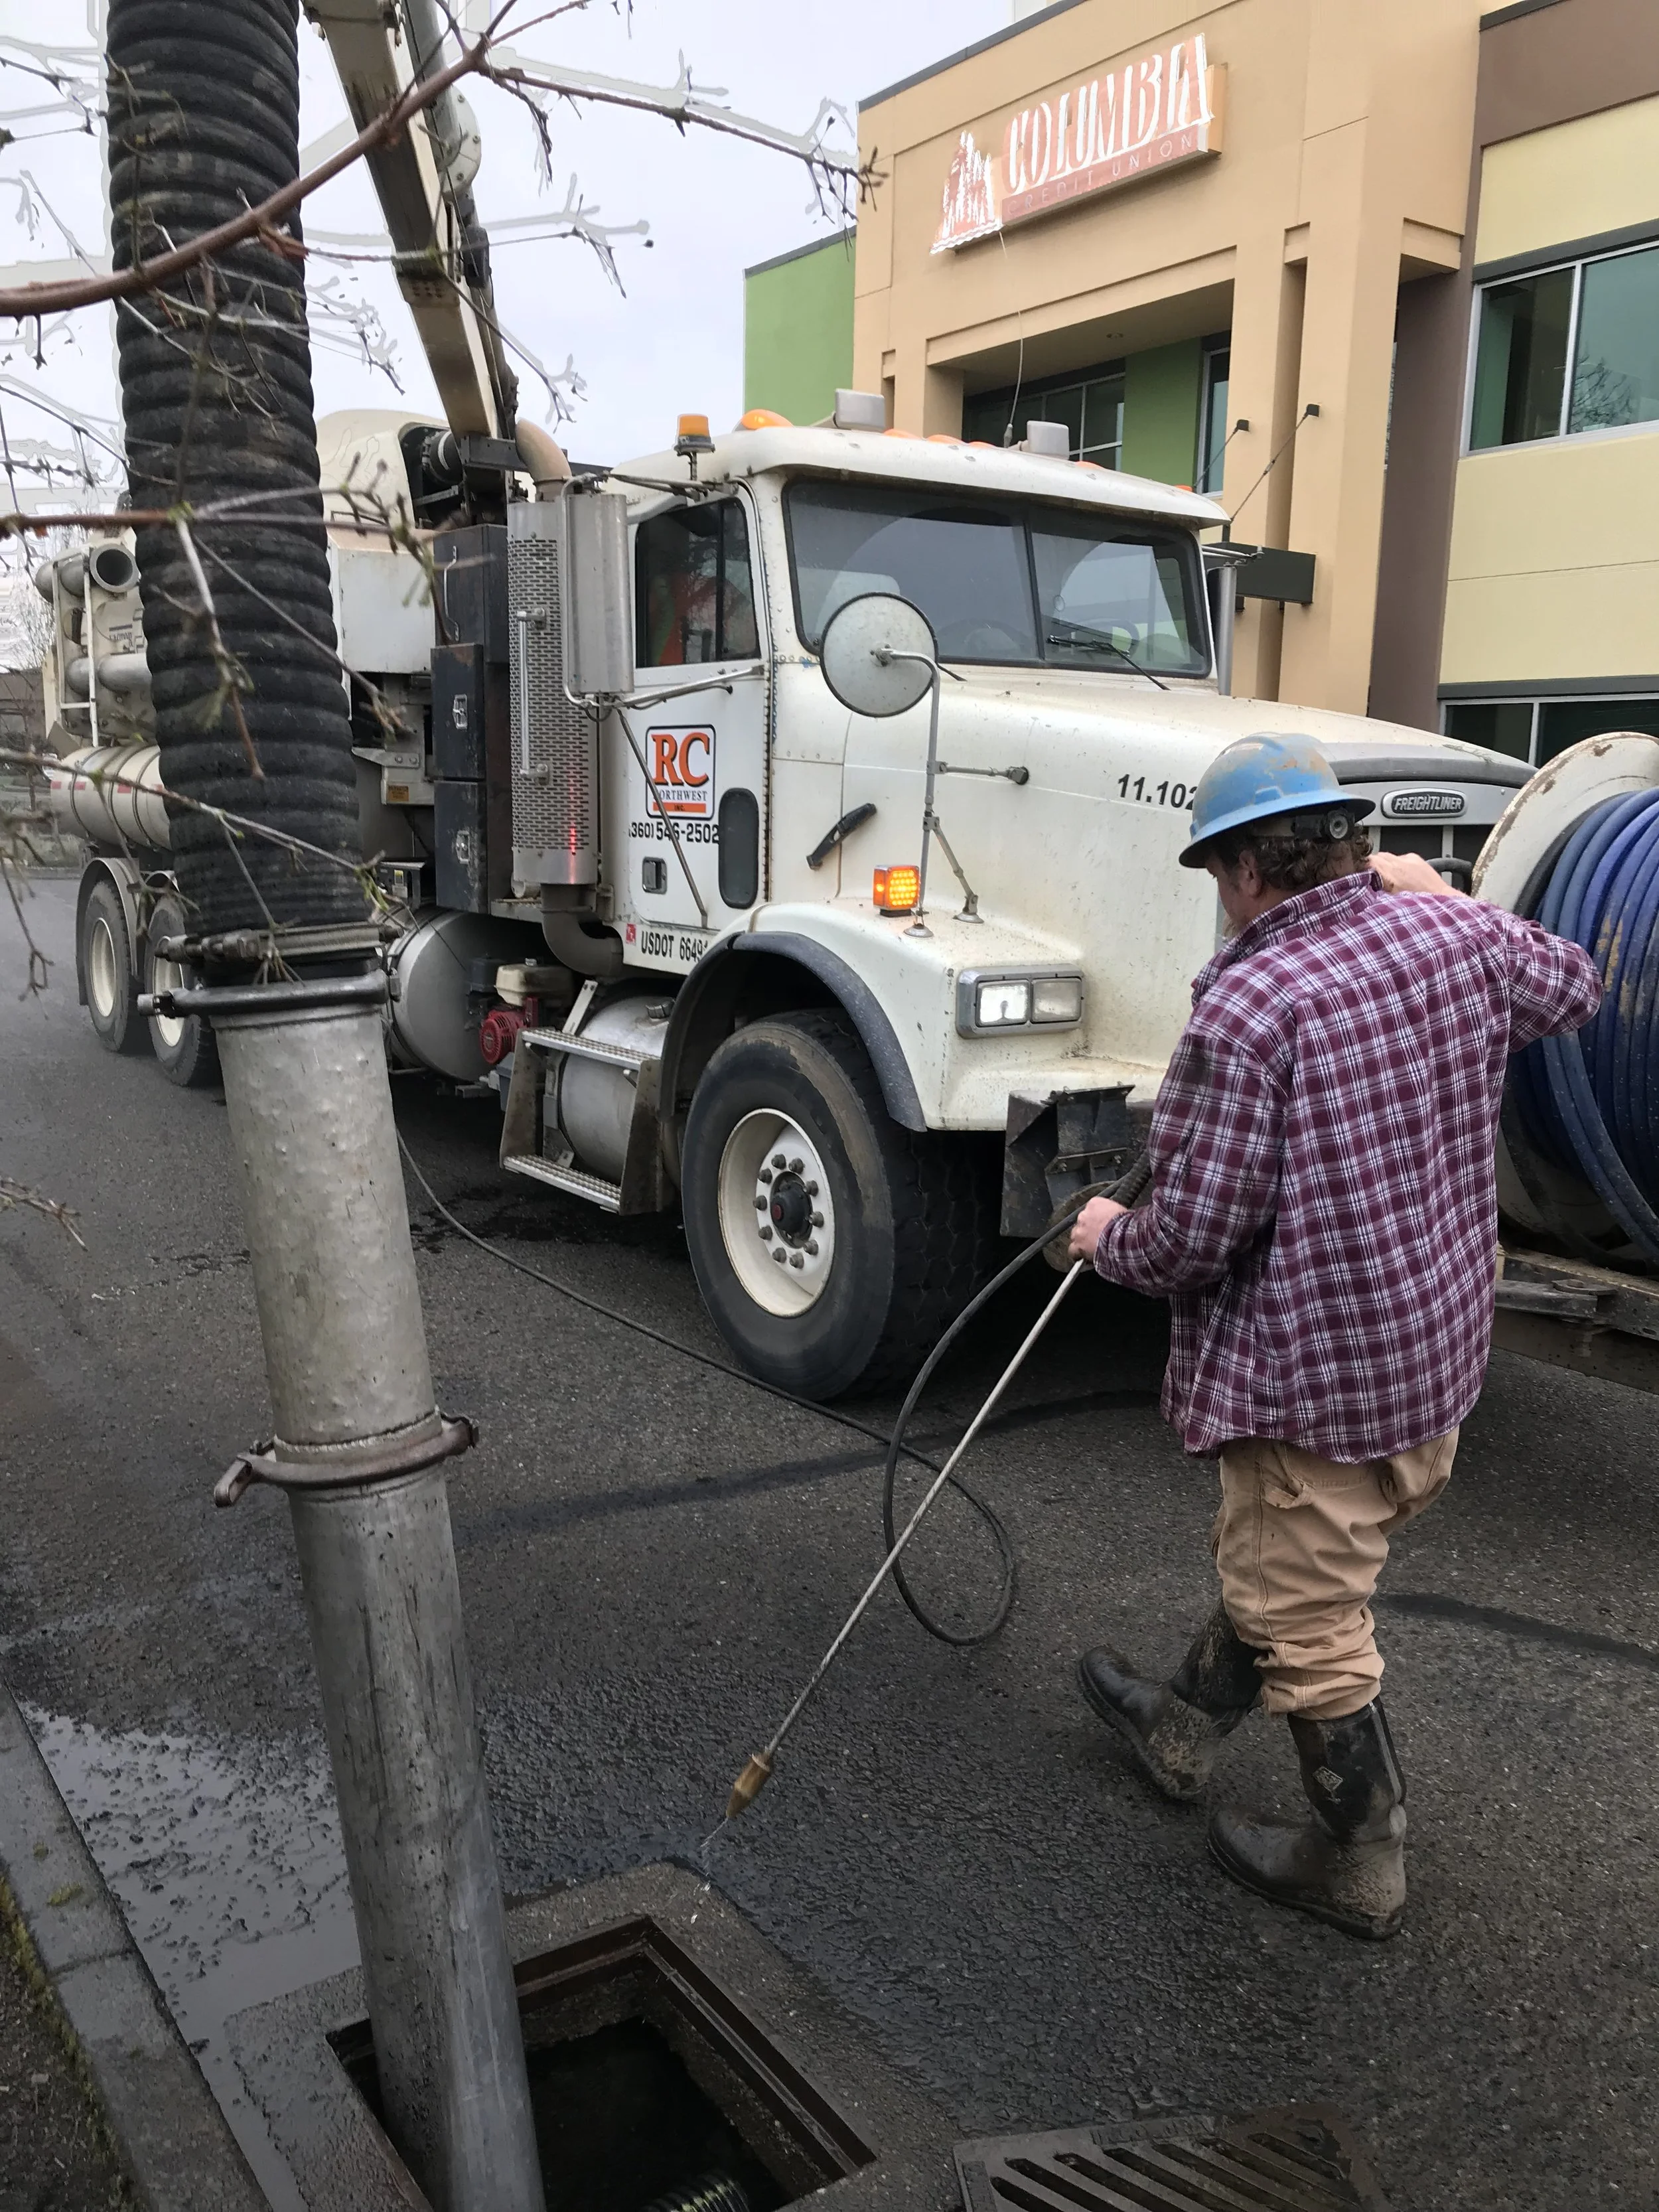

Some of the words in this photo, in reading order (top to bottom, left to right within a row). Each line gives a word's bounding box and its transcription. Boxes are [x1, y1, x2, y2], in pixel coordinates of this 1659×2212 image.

[1008, 33, 1215, 195] COLUMBIA
[1007, 170, 1094, 216] CREDIT
[1112, 133, 1193, 177] UNION
[651, 731, 710, 787] RC
[653, 789, 708, 802] ORTHWEST
[1394, 795, 1462, 811] FREIGHTLINER
[641, 930, 674, 958] USDOT
